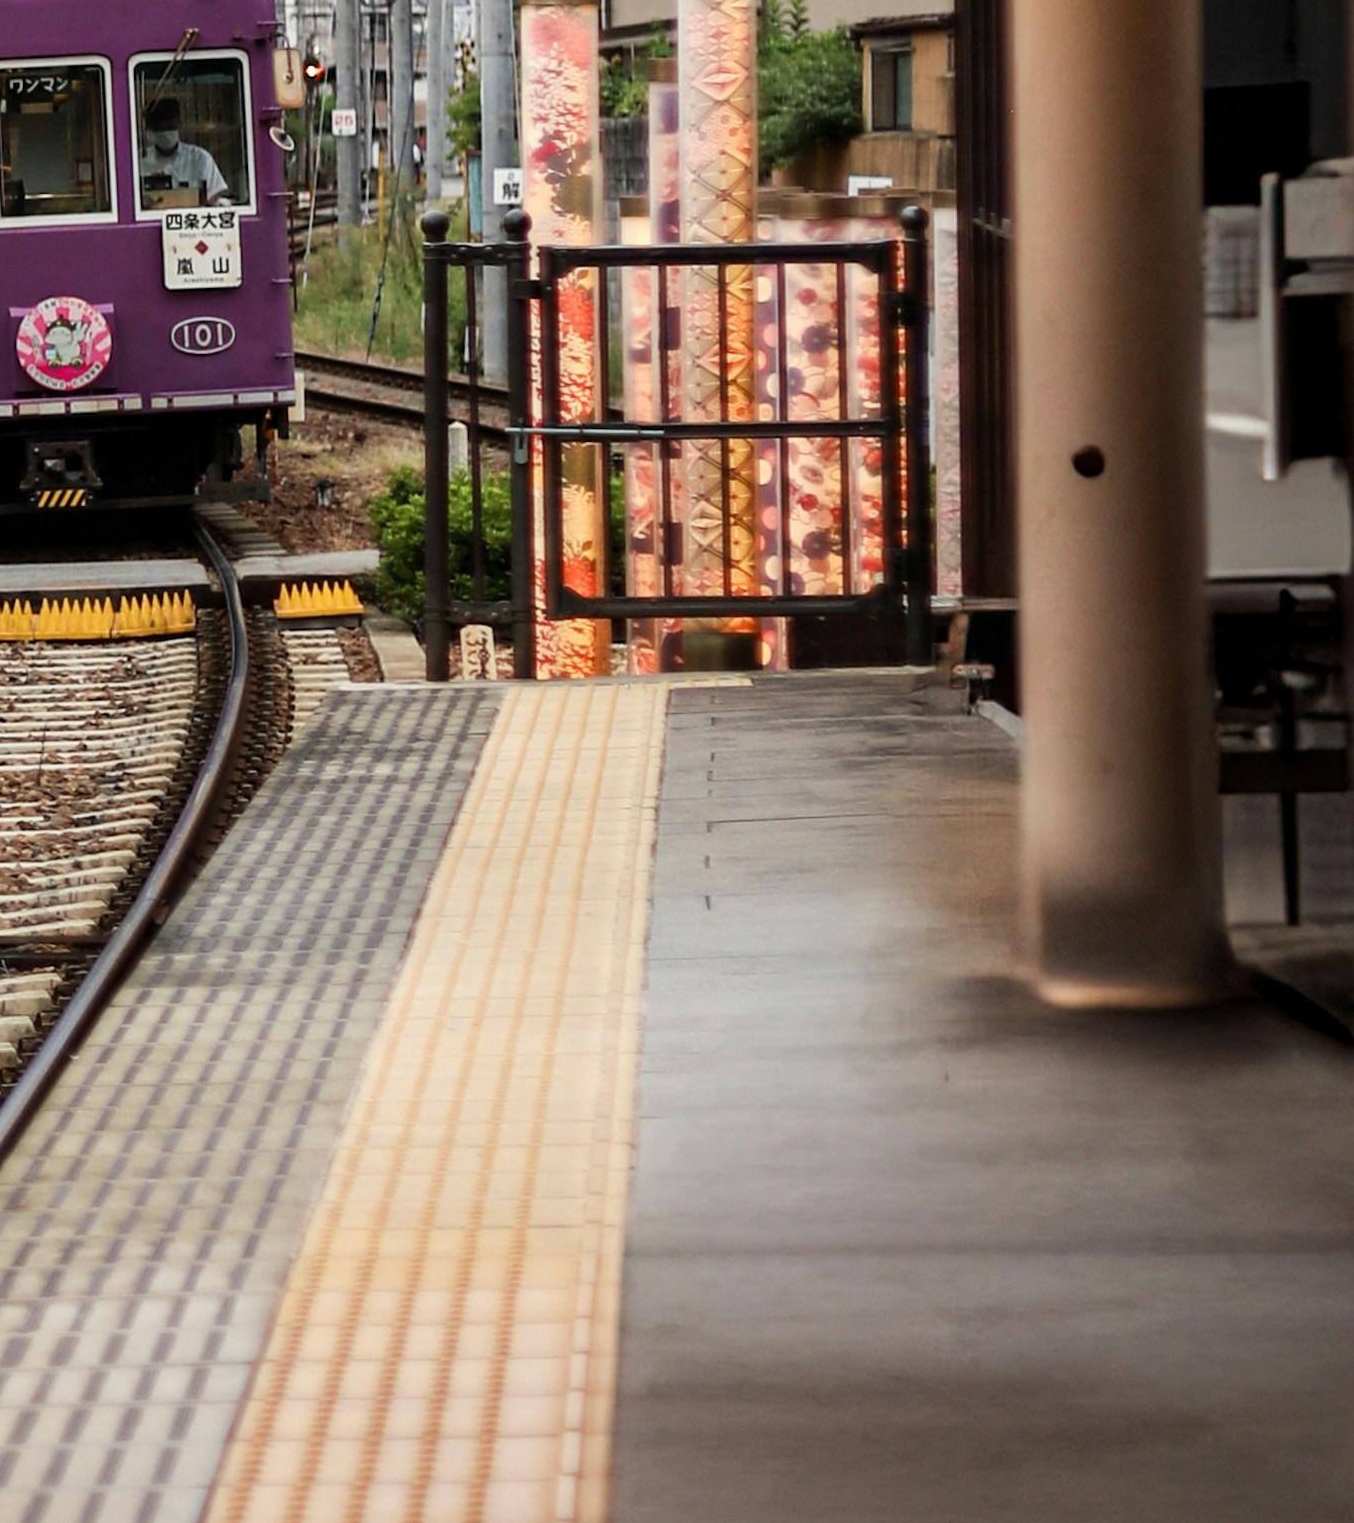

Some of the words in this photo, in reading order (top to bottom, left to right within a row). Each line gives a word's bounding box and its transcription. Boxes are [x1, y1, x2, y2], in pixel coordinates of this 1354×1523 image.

[9, 76, 69, 94] ワンマン
[166, 212, 235, 230] 四条大宮
[183, 323, 223, 348] 101
